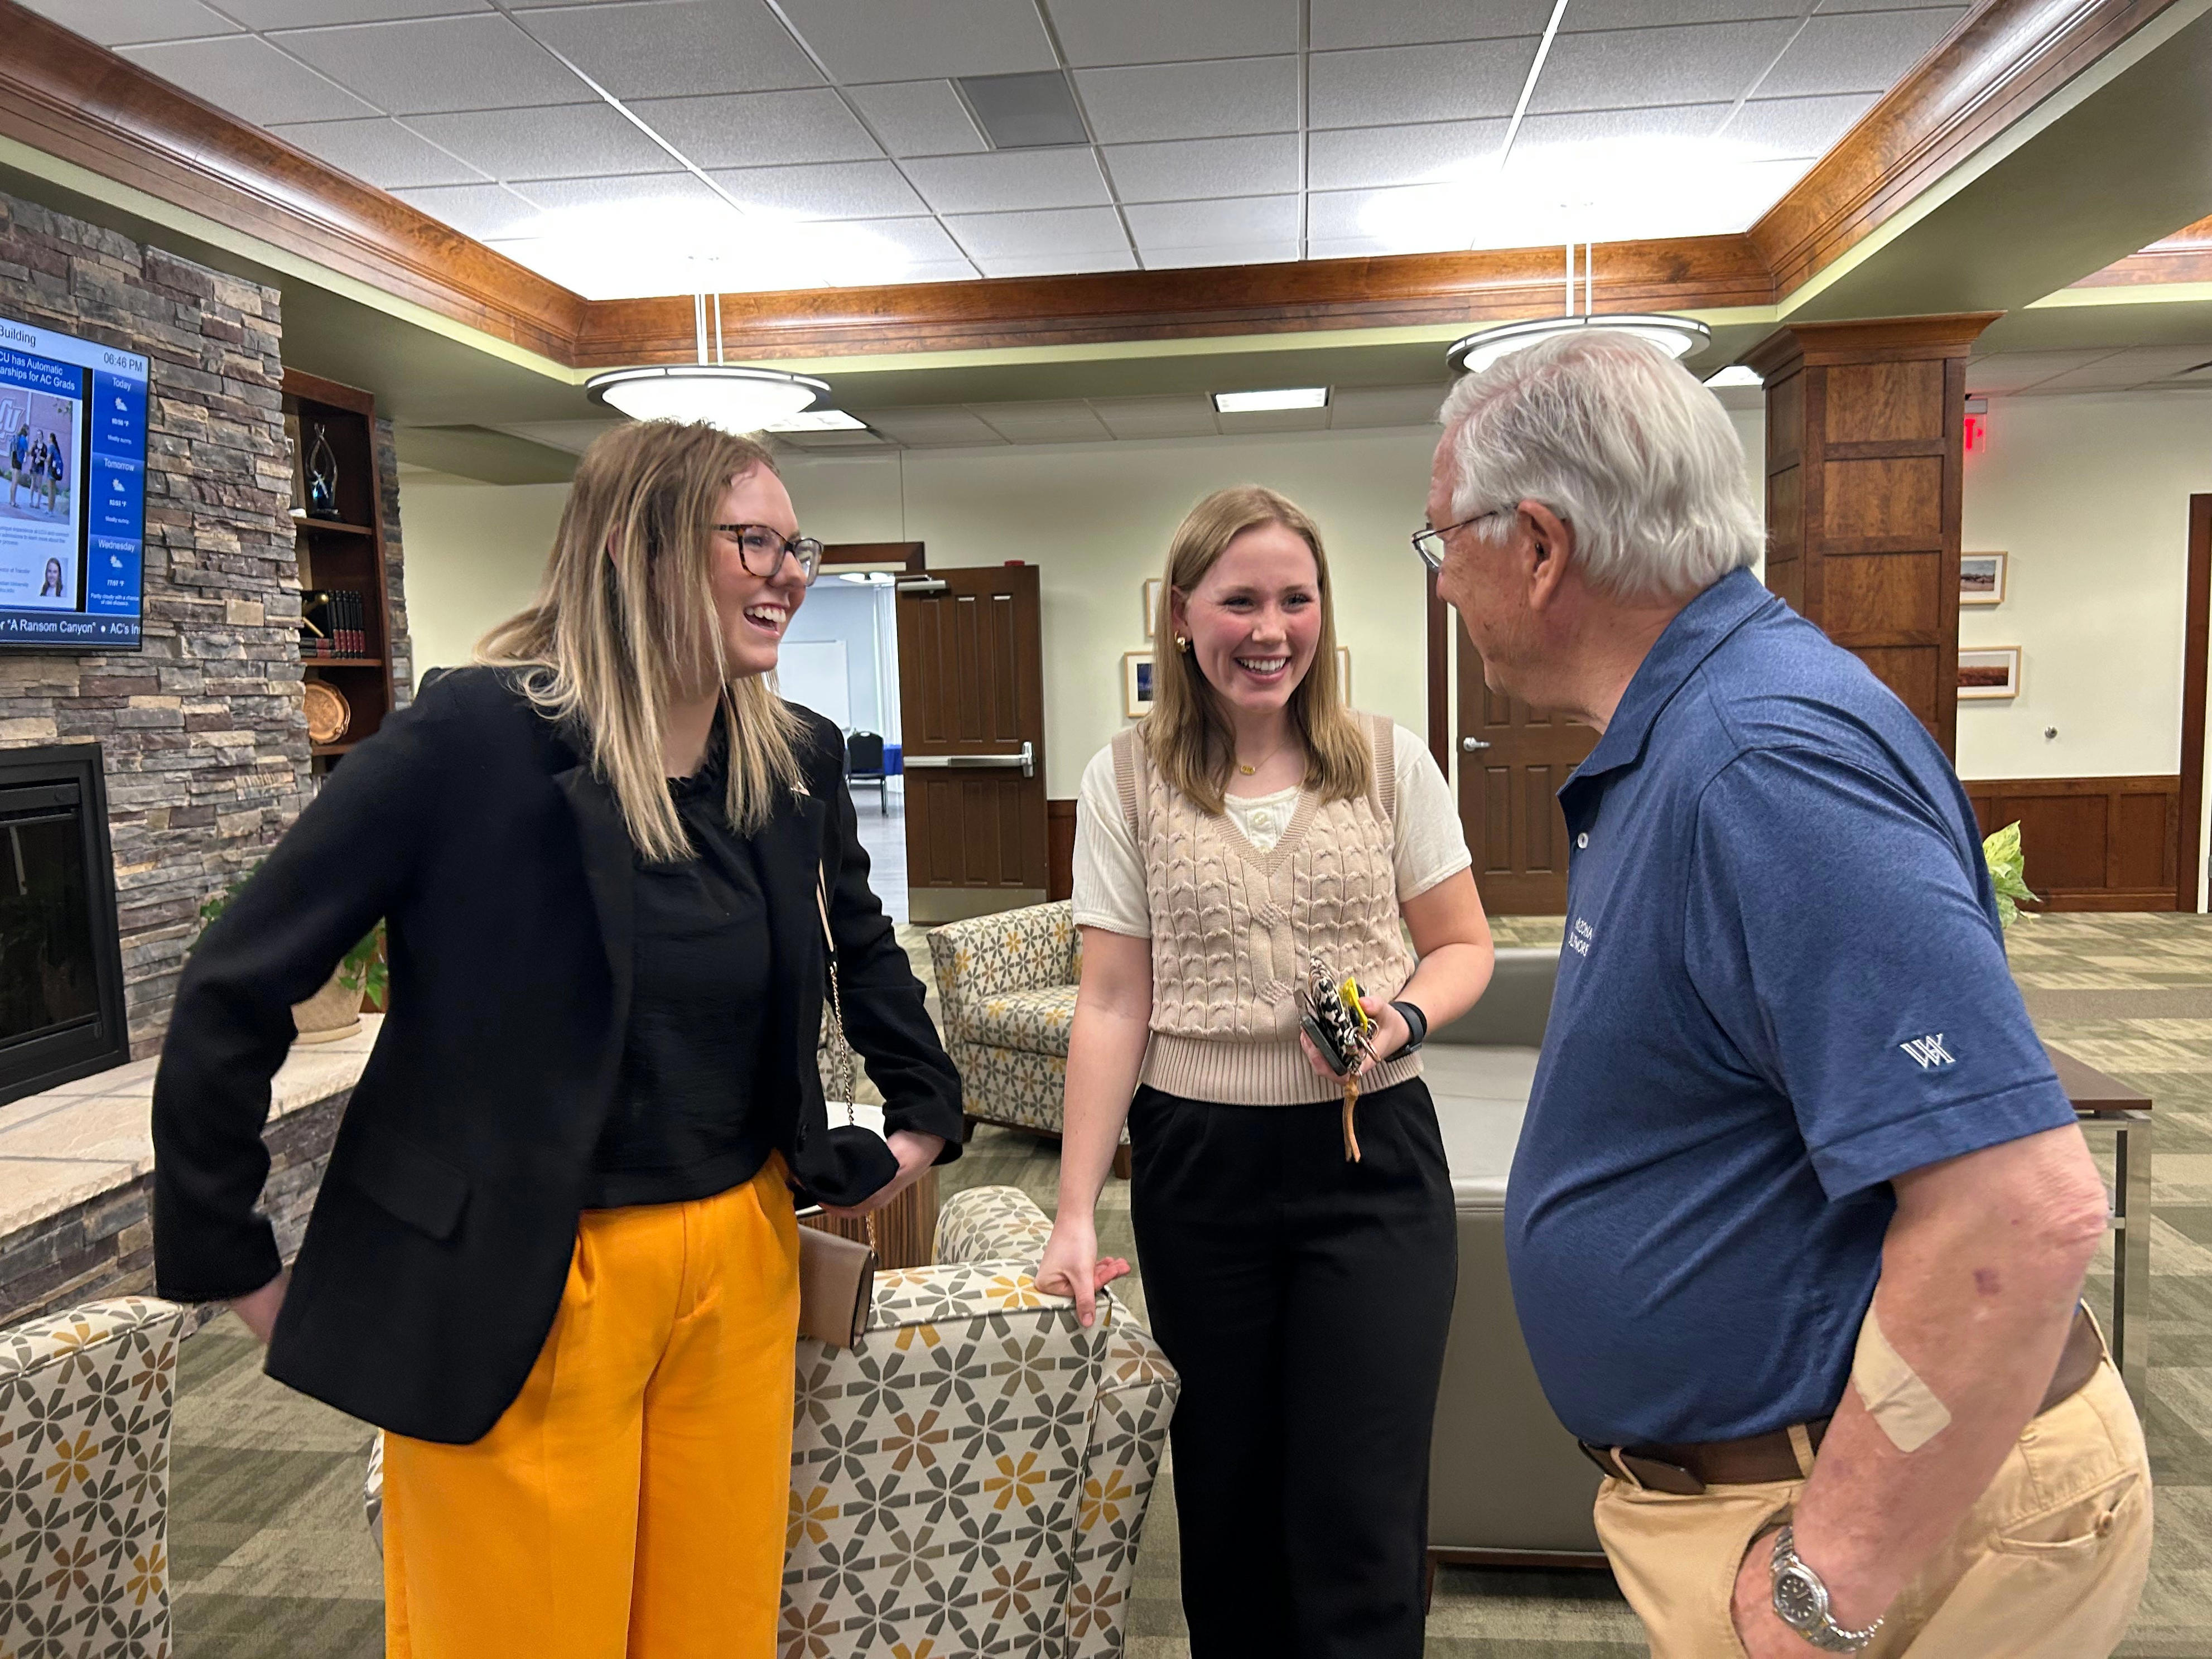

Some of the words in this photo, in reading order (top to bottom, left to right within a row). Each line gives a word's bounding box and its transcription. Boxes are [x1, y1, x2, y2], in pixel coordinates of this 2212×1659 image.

[12, 354, 25, 366] has
[26, 358, 63, 375] Automatic
[104, 352, 127, 368] 06:46
[129, 359, 142, 373] PM
[28, 370, 38, 382] for
[40, 374, 51, 385] AC
[54, 377, 75, 390] Grads
[112, 377, 132, 391] Today
[104, 457, 134, 471] Tomorrow
[98, 539, 135, 553] Wednesday
[20, 619, 56, 633] Ransom
